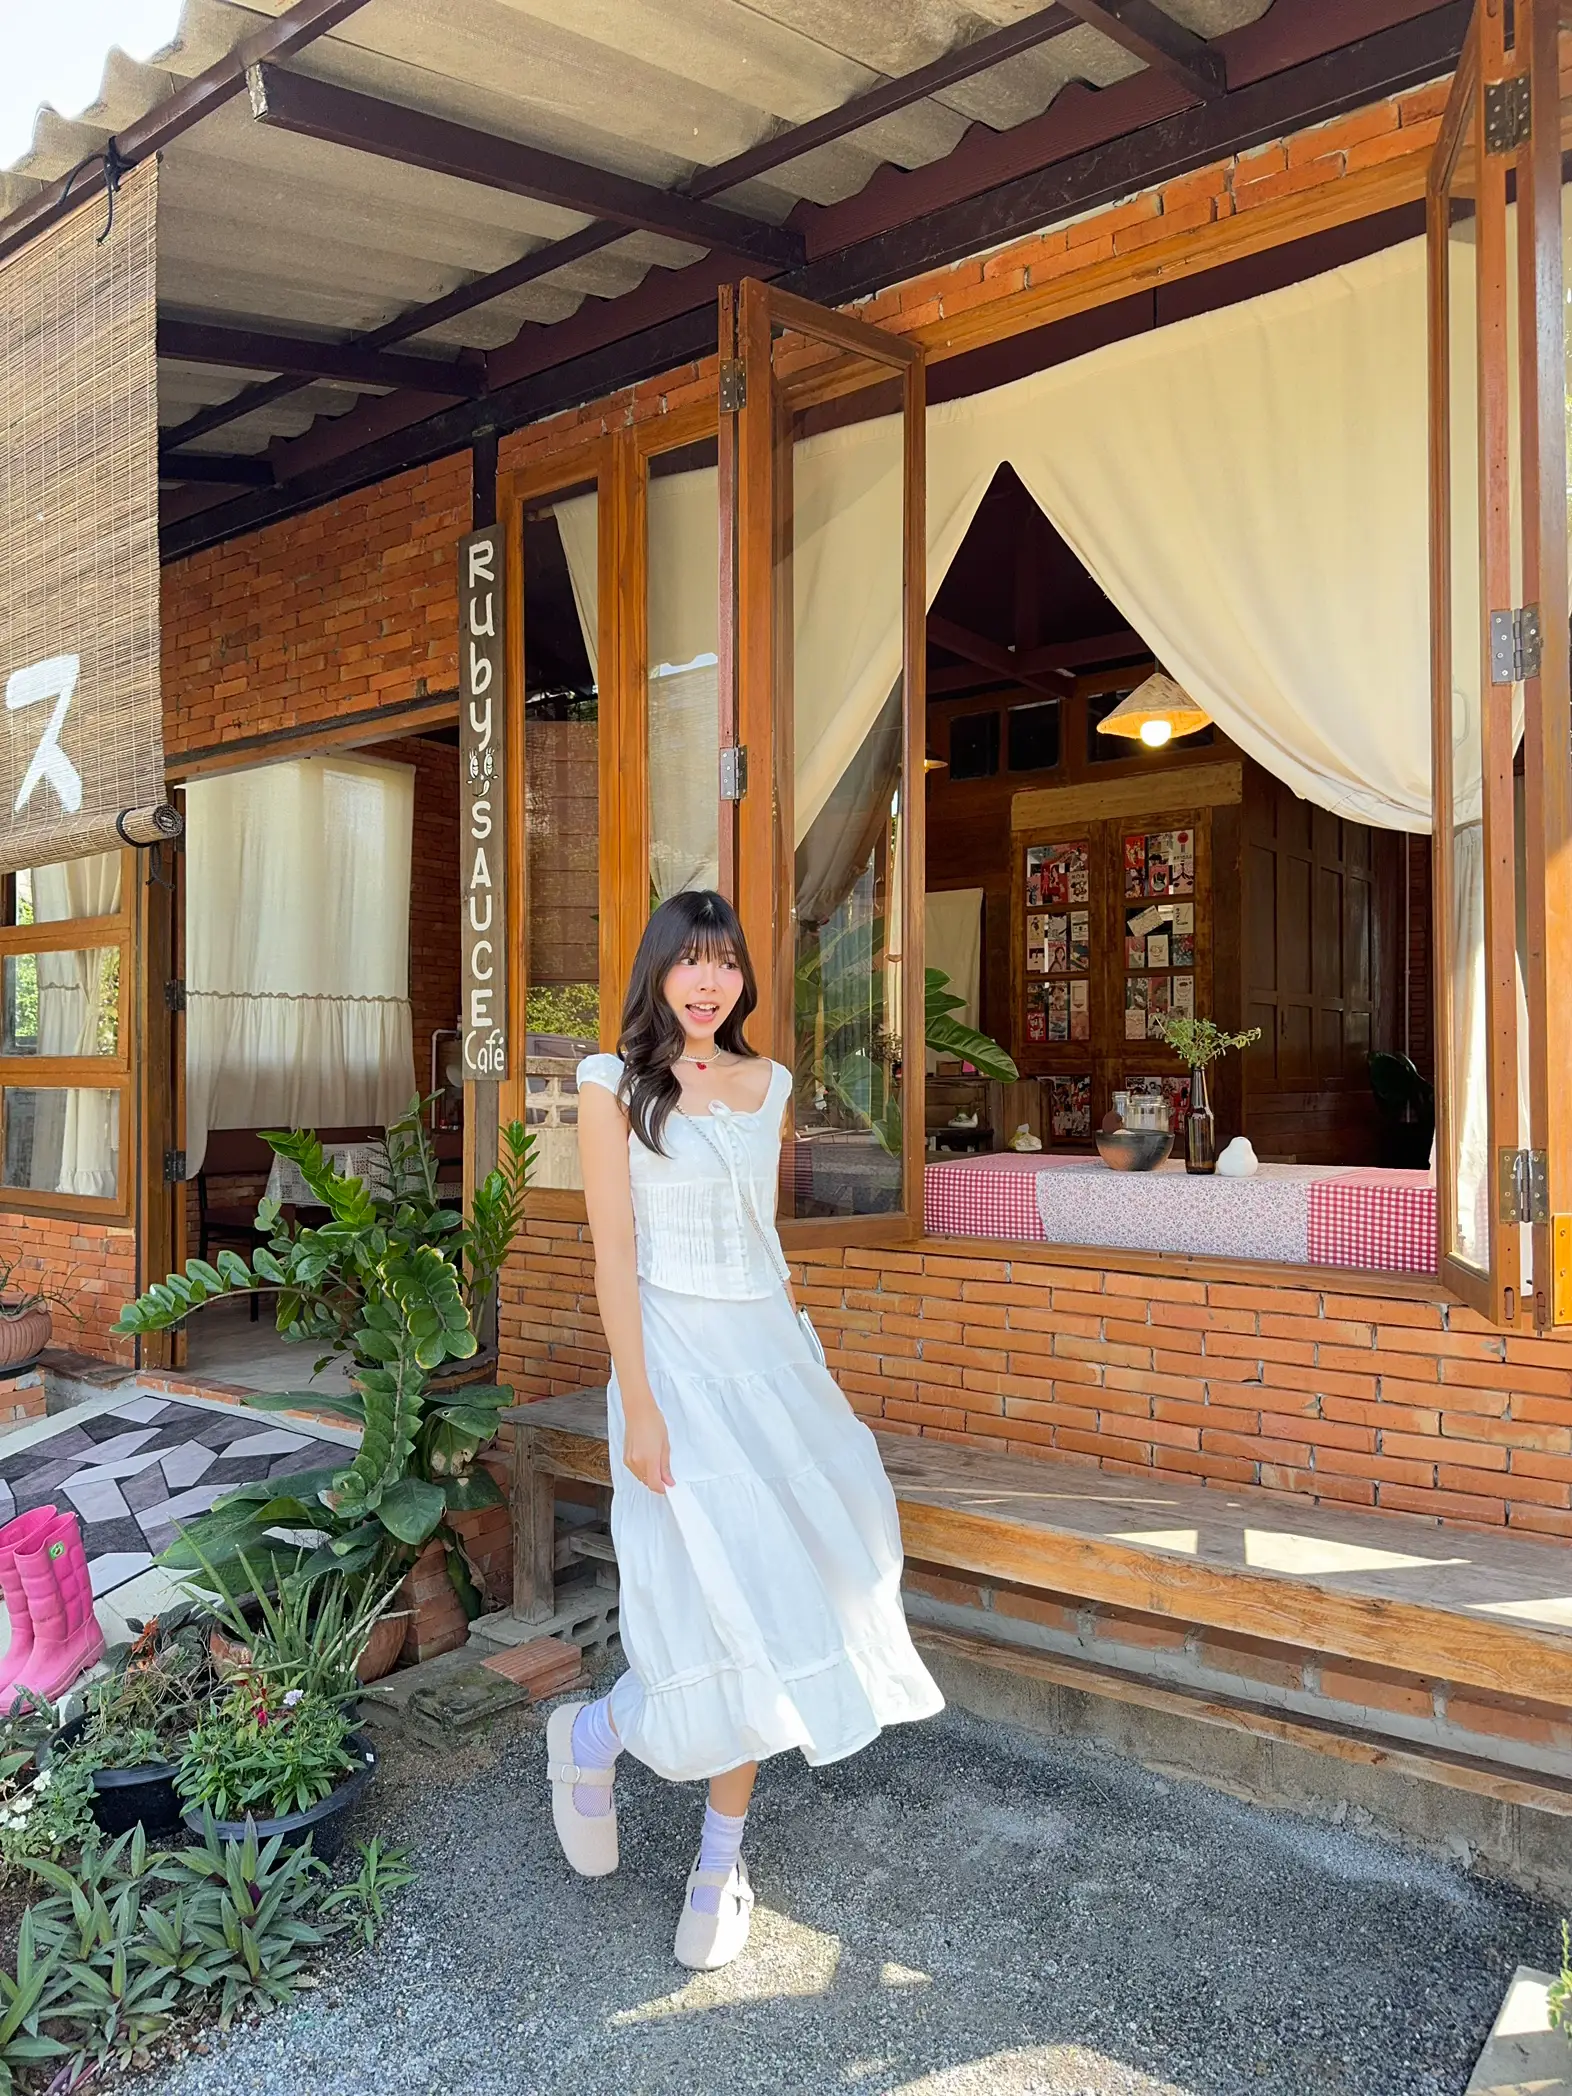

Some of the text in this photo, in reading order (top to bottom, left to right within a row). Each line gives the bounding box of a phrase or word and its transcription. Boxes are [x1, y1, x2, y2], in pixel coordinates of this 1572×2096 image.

[6, 653, 83, 813] ス
[469, 540, 495, 1027] Ruby SAUCE
[465, 1029, 504, 1073] Café
